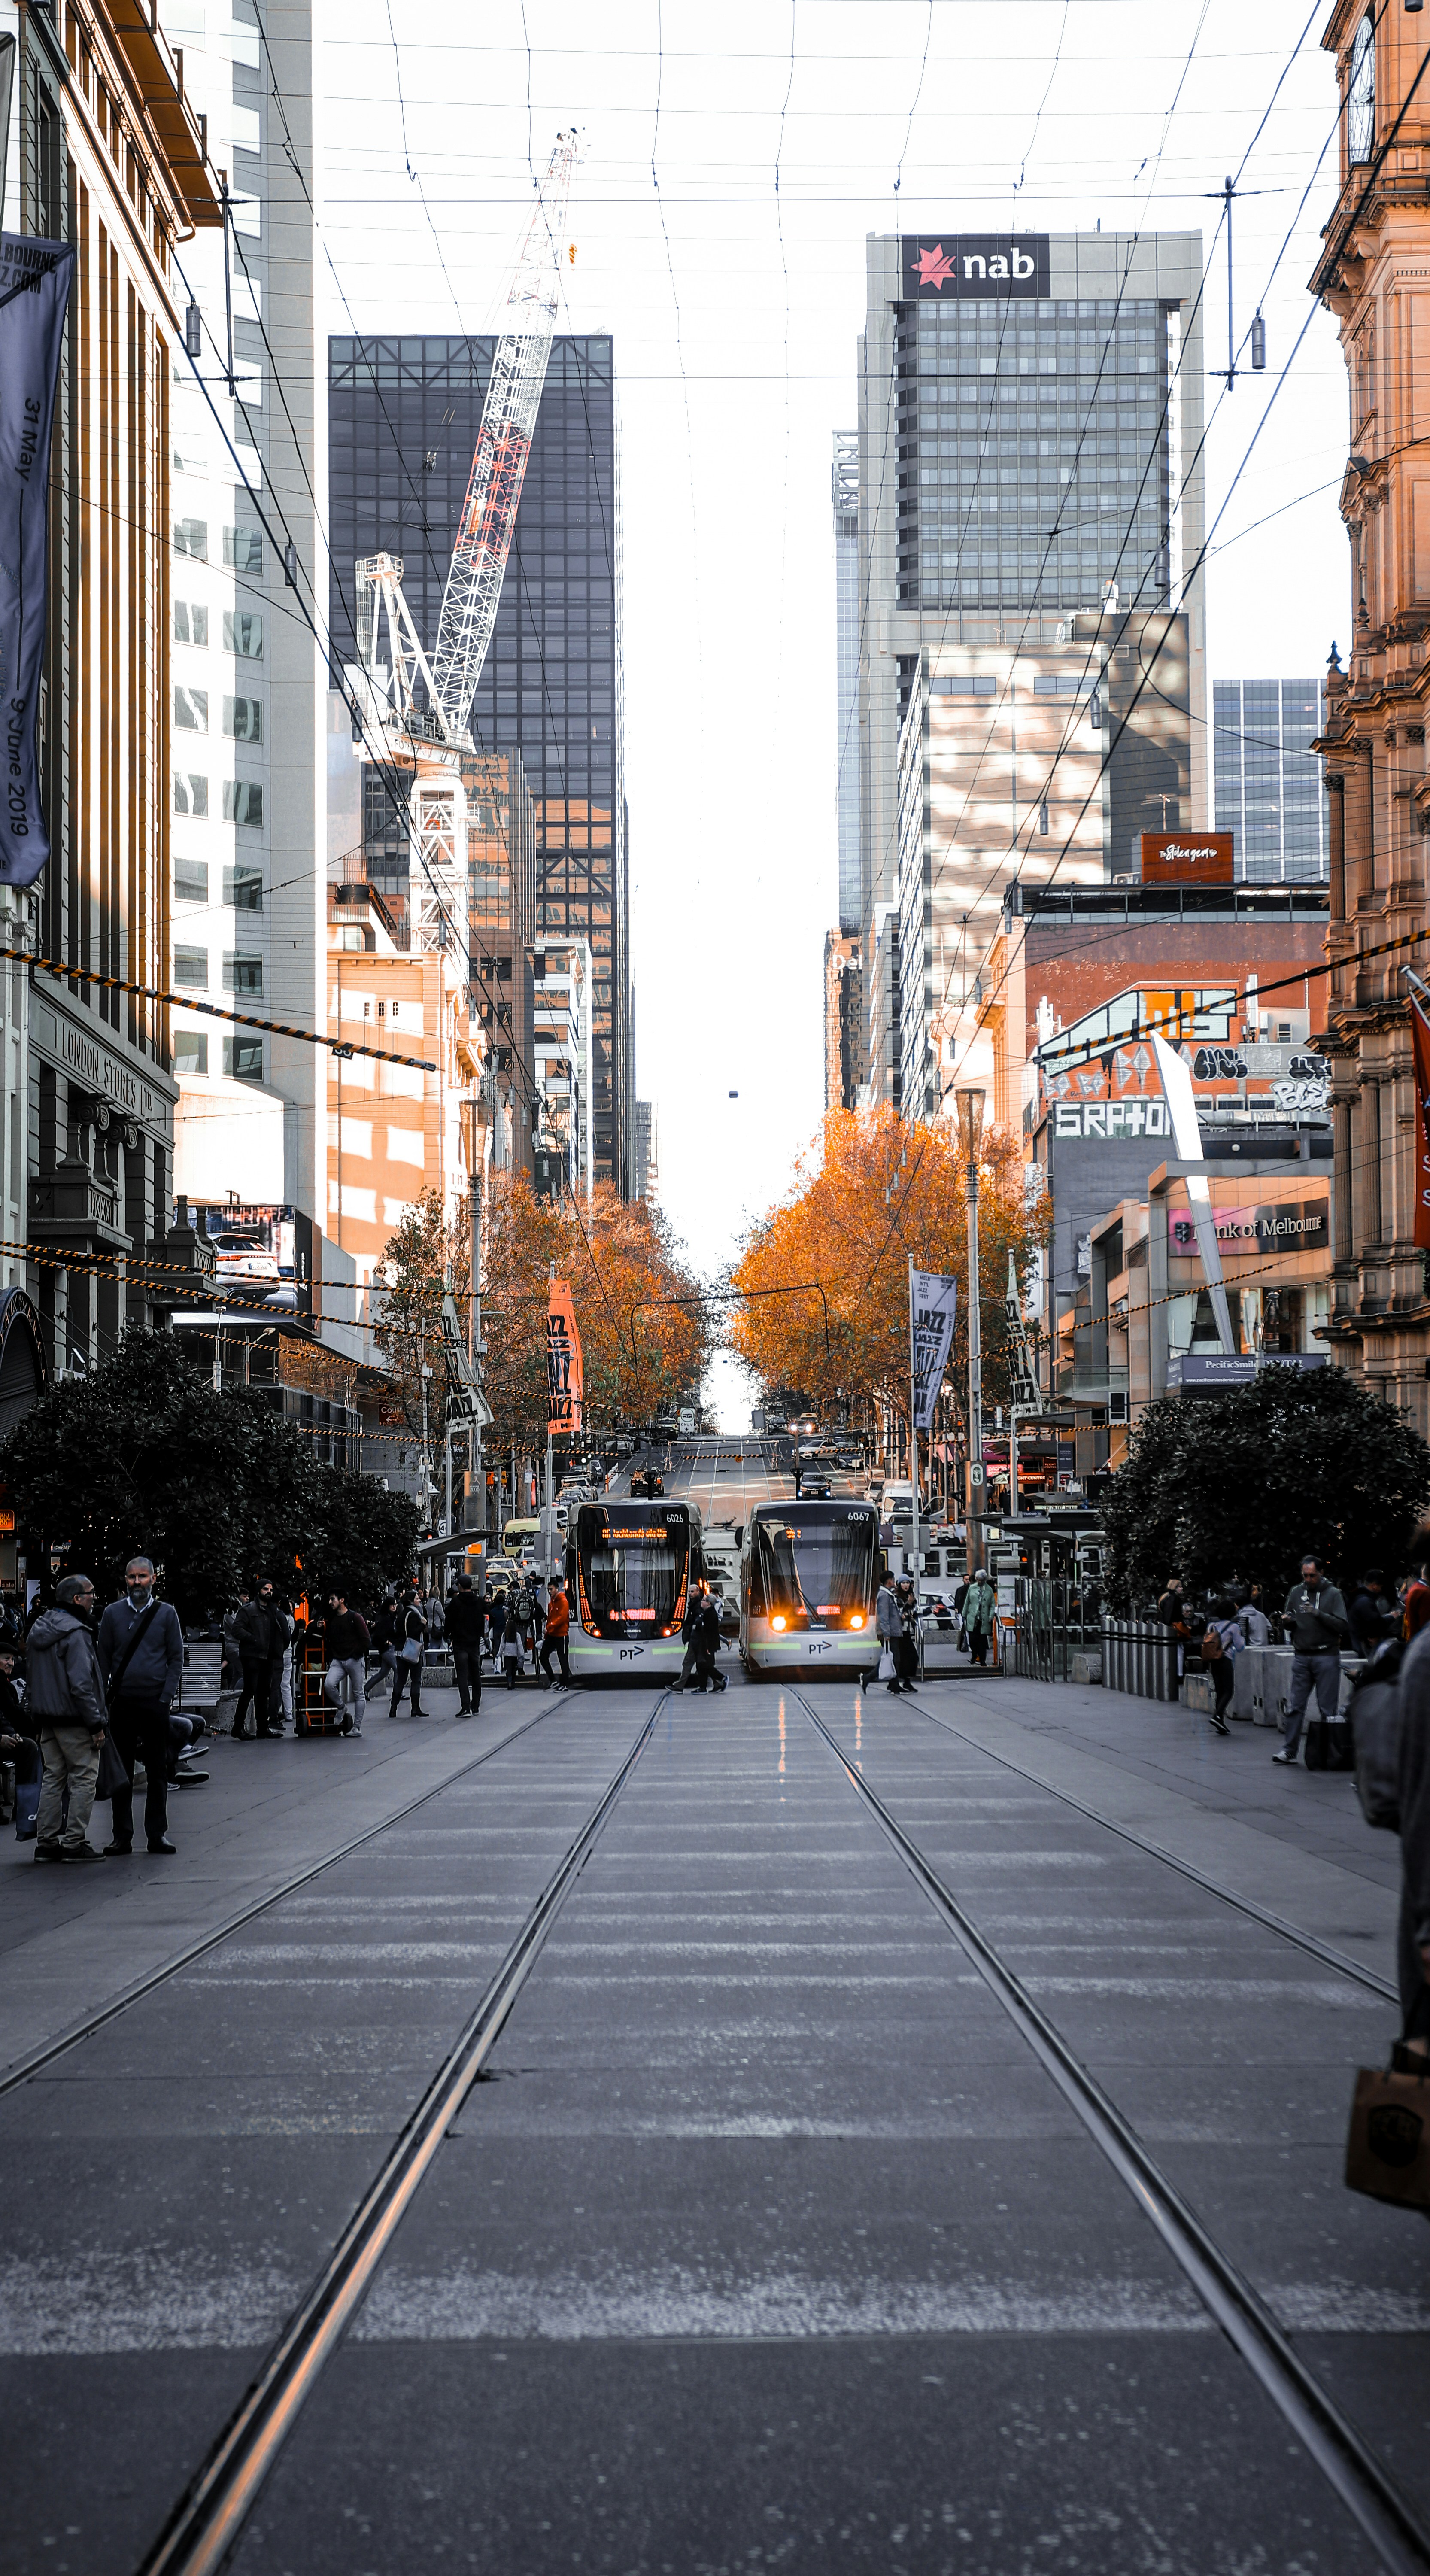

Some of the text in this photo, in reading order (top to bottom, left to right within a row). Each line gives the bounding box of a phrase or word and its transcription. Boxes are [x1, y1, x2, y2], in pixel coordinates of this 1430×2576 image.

[0, 243, 58, 273] BOURNE
[963, 247, 1035, 279] nab
[15, 398, 41, 482] 31 May
[8, 698, 29, 836] 9 June 2019
[63, 1023, 98, 1082] LONDON
[104, 1057, 136, 1109] STORES
[1242, 1221, 1258, 1237] of
[1262, 1215, 1322, 1236] Melbourne
[1205, 1360, 1257, 1368] PacificSmil
[667, 1514, 684, 1523] 6026
[848, 1512, 870, 1521] 6067
